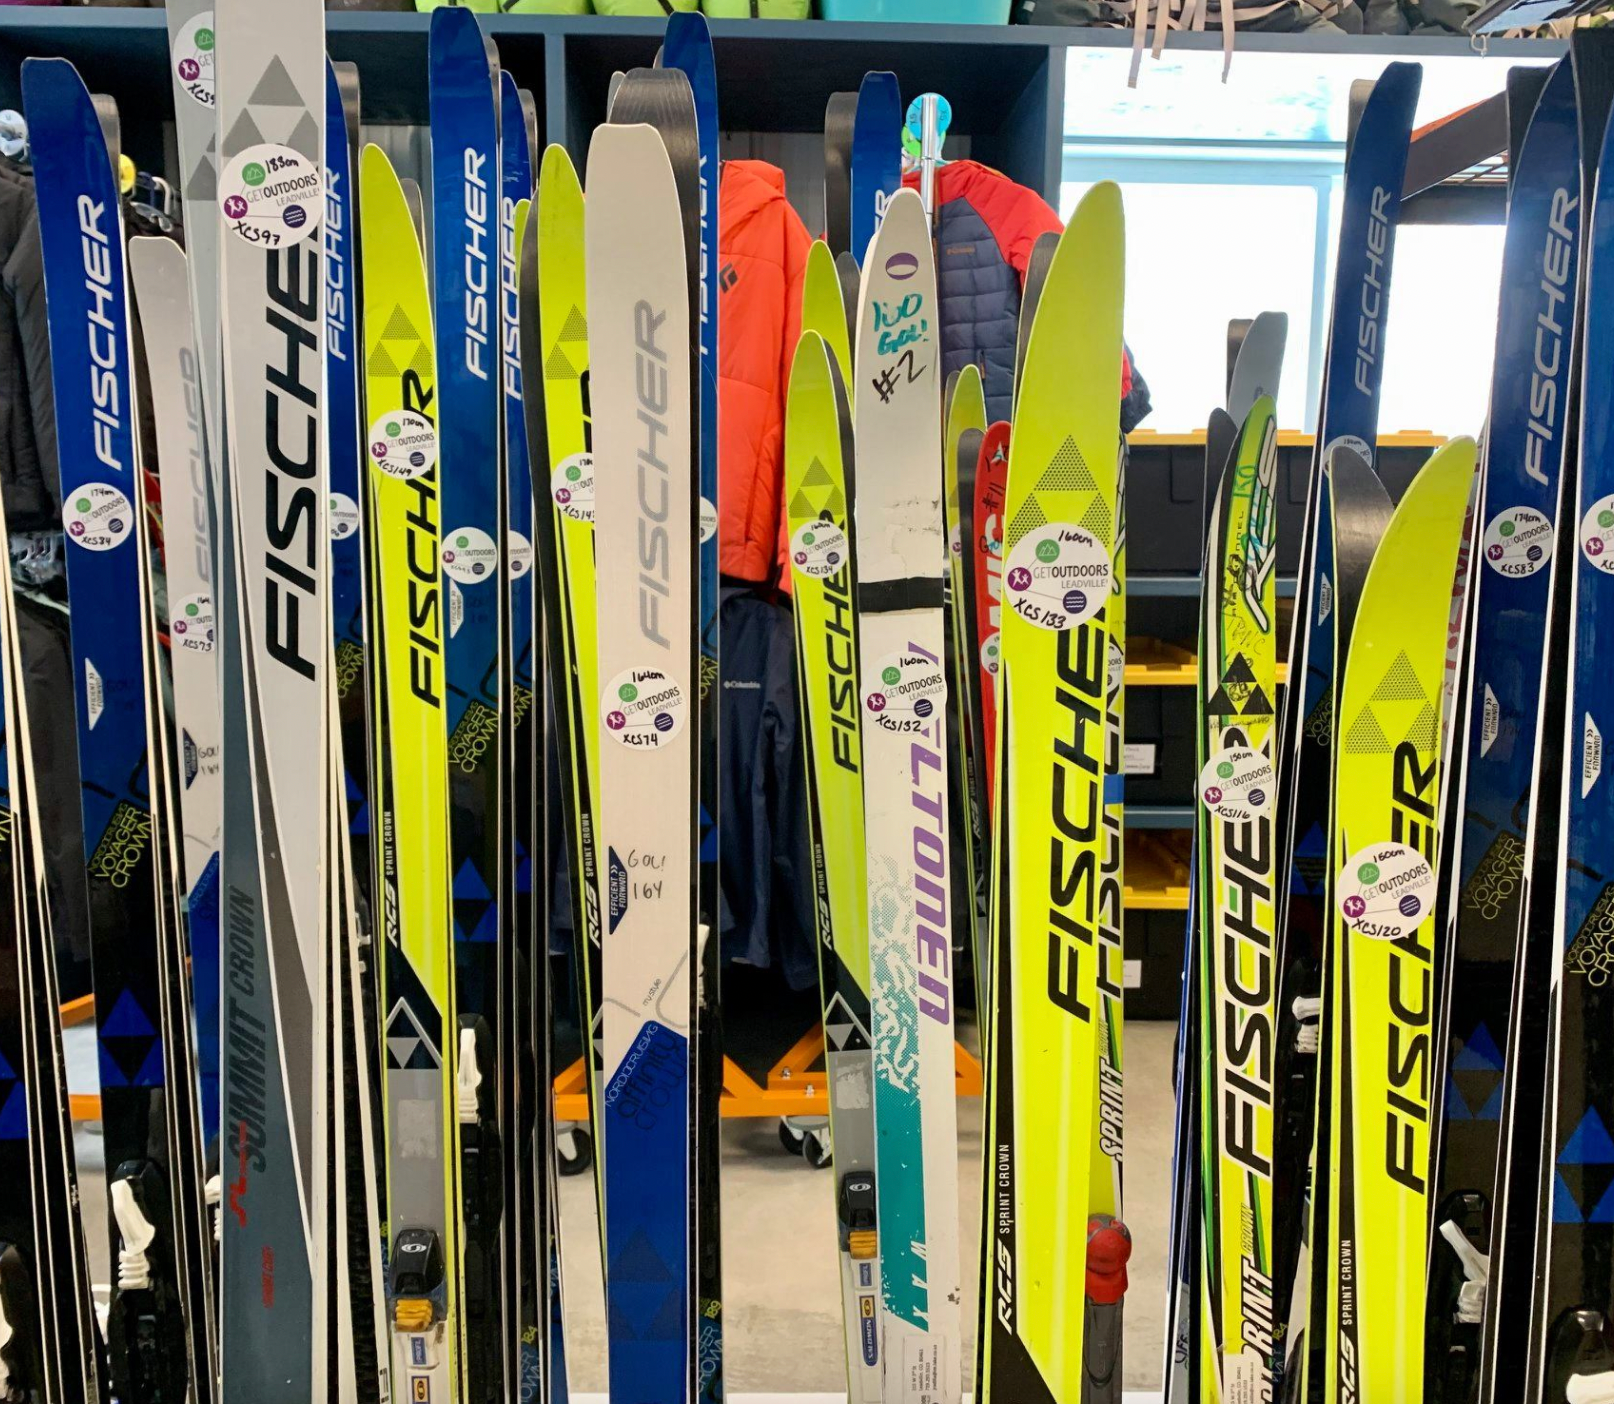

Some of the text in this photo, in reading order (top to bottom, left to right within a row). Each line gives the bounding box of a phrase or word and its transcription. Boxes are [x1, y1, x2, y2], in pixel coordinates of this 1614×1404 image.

[265, 155, 299, 174] 183cm
[232, 220, 281, 247] XCS97
[325, 167, 347, 361] FISCHER
[463, 147, 488, 380] FISCHER
[1355, 185, 1391, 396] FISCHER
[77, 195, 122, 471] FISCHER
[1525, 187, 1579, 487] FISCHER
[265, 227, 318, 682] FISCHE
[634, 300, 670, 650] FISCHER
[1058, 530, 1093, 548] 160cm
[1501, 561, 1535, 574] XCS83
[1013, 597, 1067, 629] XCS133
[632, 671, 665, 683] 164cm
[900, 657, 929, 668] 160cm
[449, 705, 488, 764] VOYAGER
[461, 709, 500, 773] CROWN
[623, 733, 659, 747] XCS74
[875, 712, 921, 733] XCS132
[1483, 708, 1491, 741] EFFICIENT
[1584, 740, 1593, 779] EFFICIENT
[1047, 606, 1107, 1024] FISCHE
[1214, 804, 1251, 820] XCS116
[94, 806, 142, 878] VOYAGER
[110, 811, 156, 888] CROWN
[383, 811, 398, 949] RCS SPRINT CROWN
[581, 813, 601, 950] RCS SPRINT CROWN
[610, 876, 619, 916] EFFICIENT
[618, 871, 626, 909] FORWARD
[815, 843, 832, 951] RCS SPRINT CROWN
[1466, 838, 1522, 909] VOYAGER
[1351, 918, 1402, 938] XCS120
[227, 885, 267, 1174] SUMMIT CROWN
[1099, 1055, 1123, 1162] SPRINT
[997, 1144, 1013, 1335] RCS SPRINT CROWN
[1240, 1202, 1254, 1256] CROWN
[1341, 1239, 1352, 1280] CROWN
[1341, 1285, 1352, 1326] SPRINT
